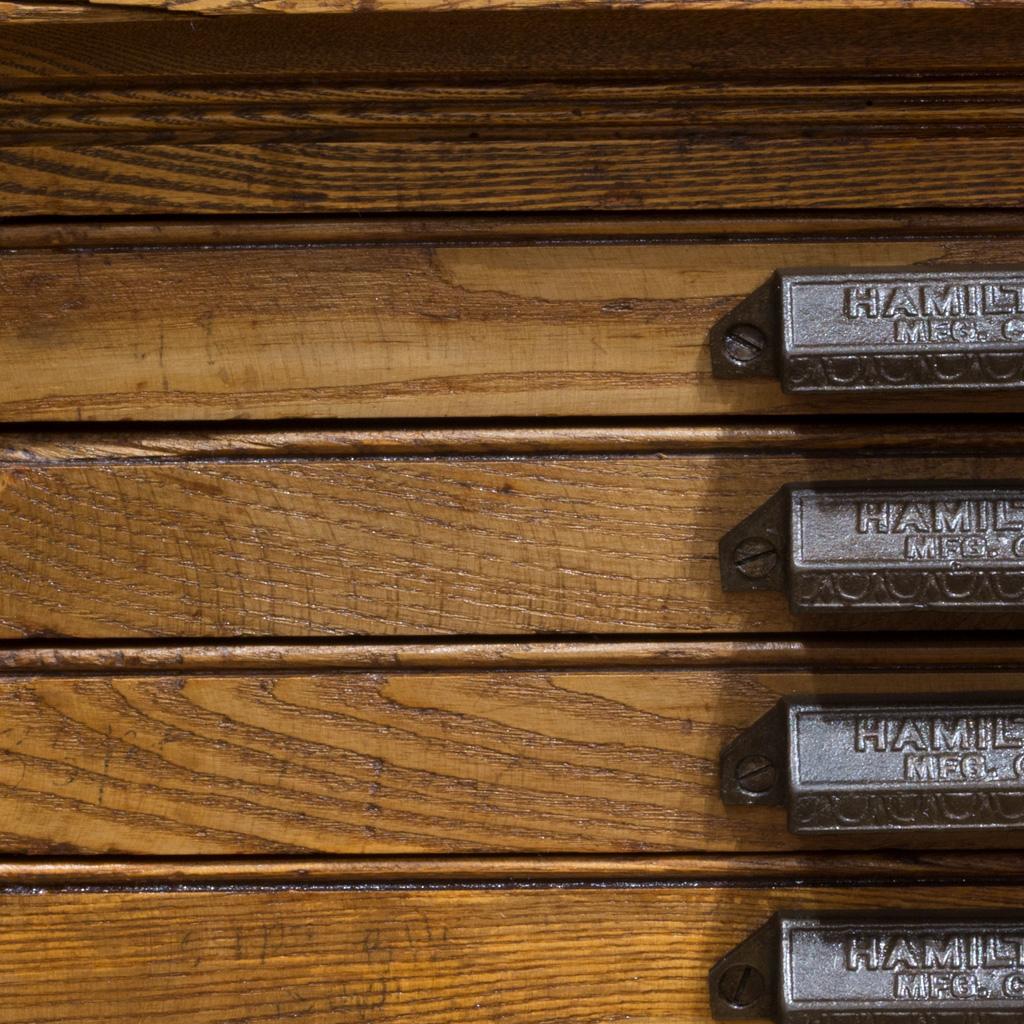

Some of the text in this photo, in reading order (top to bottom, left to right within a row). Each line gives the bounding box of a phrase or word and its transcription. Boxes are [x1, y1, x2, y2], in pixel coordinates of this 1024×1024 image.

[894, 319, 987, 342] MFG.
[905, 535, 998, 560] MFG.
[904, 752, 997, 779] MFG.
[894, 972, 987, 998] MFG.
